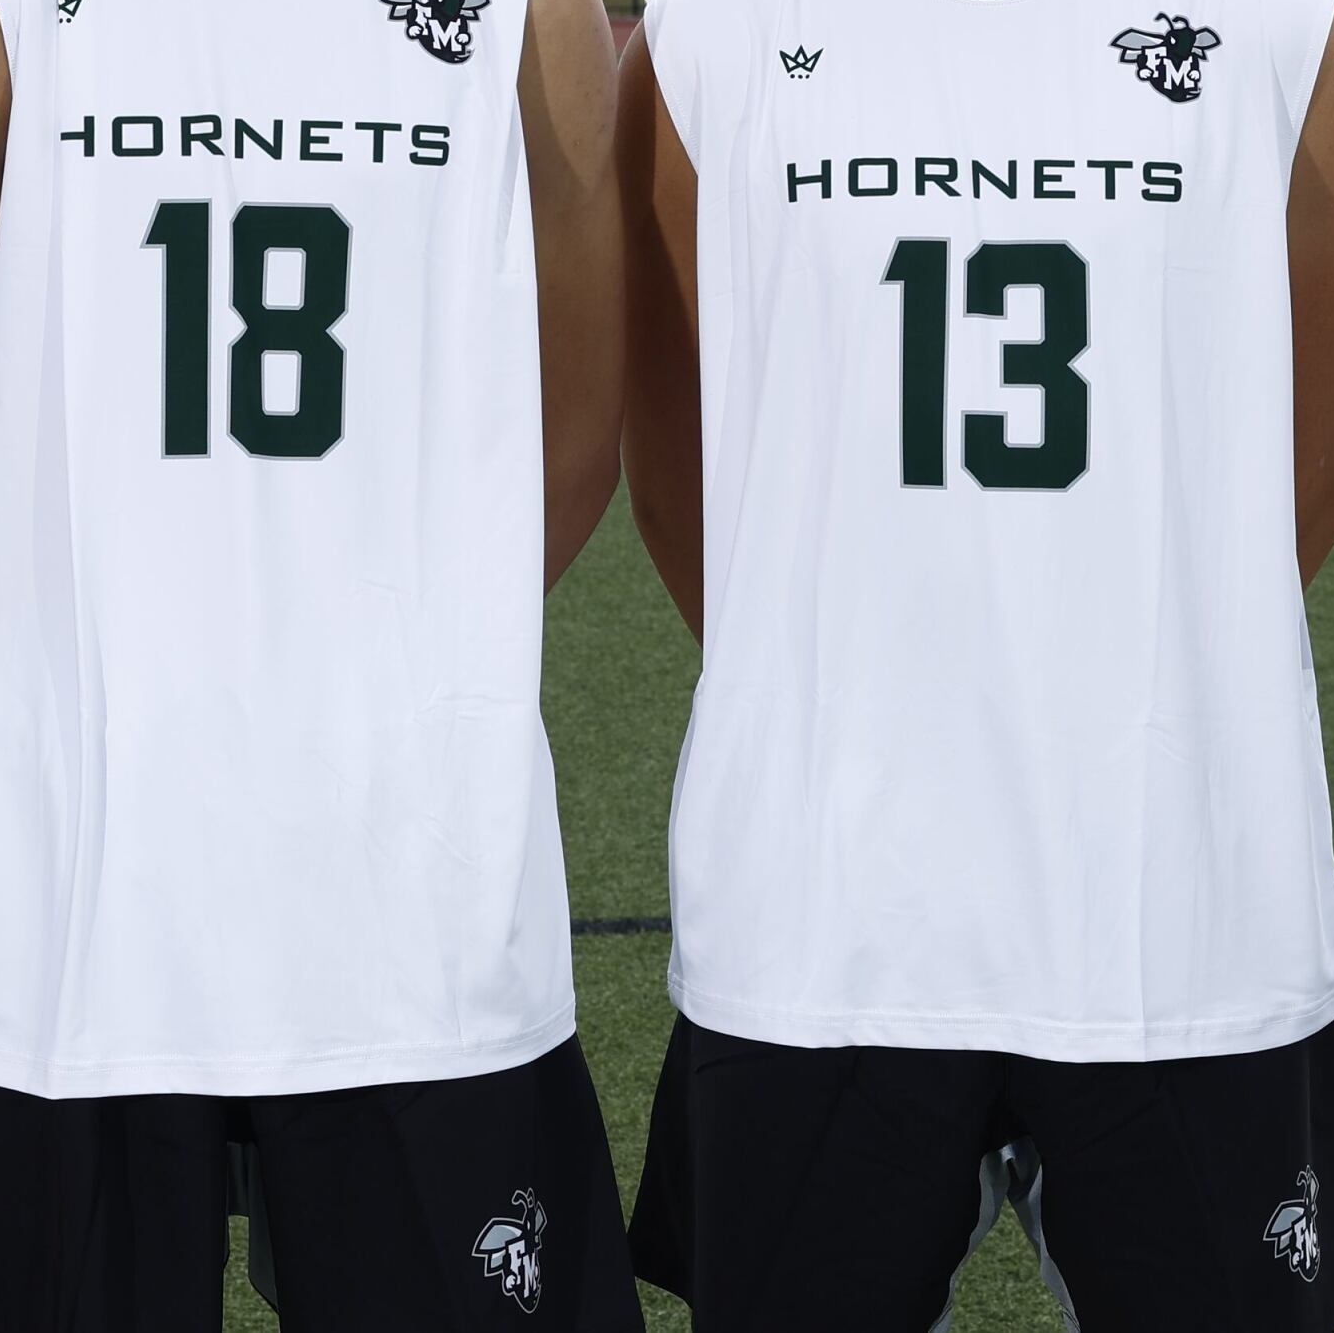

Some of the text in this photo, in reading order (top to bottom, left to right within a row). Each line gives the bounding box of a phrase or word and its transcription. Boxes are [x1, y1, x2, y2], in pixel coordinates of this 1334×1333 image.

[60, 113, 451, 167] HORNETS
[786, 156, 1184, 203] HORNETS
[139, 197, 354, 461] 18
[879, 236, 1091, 493] 13
